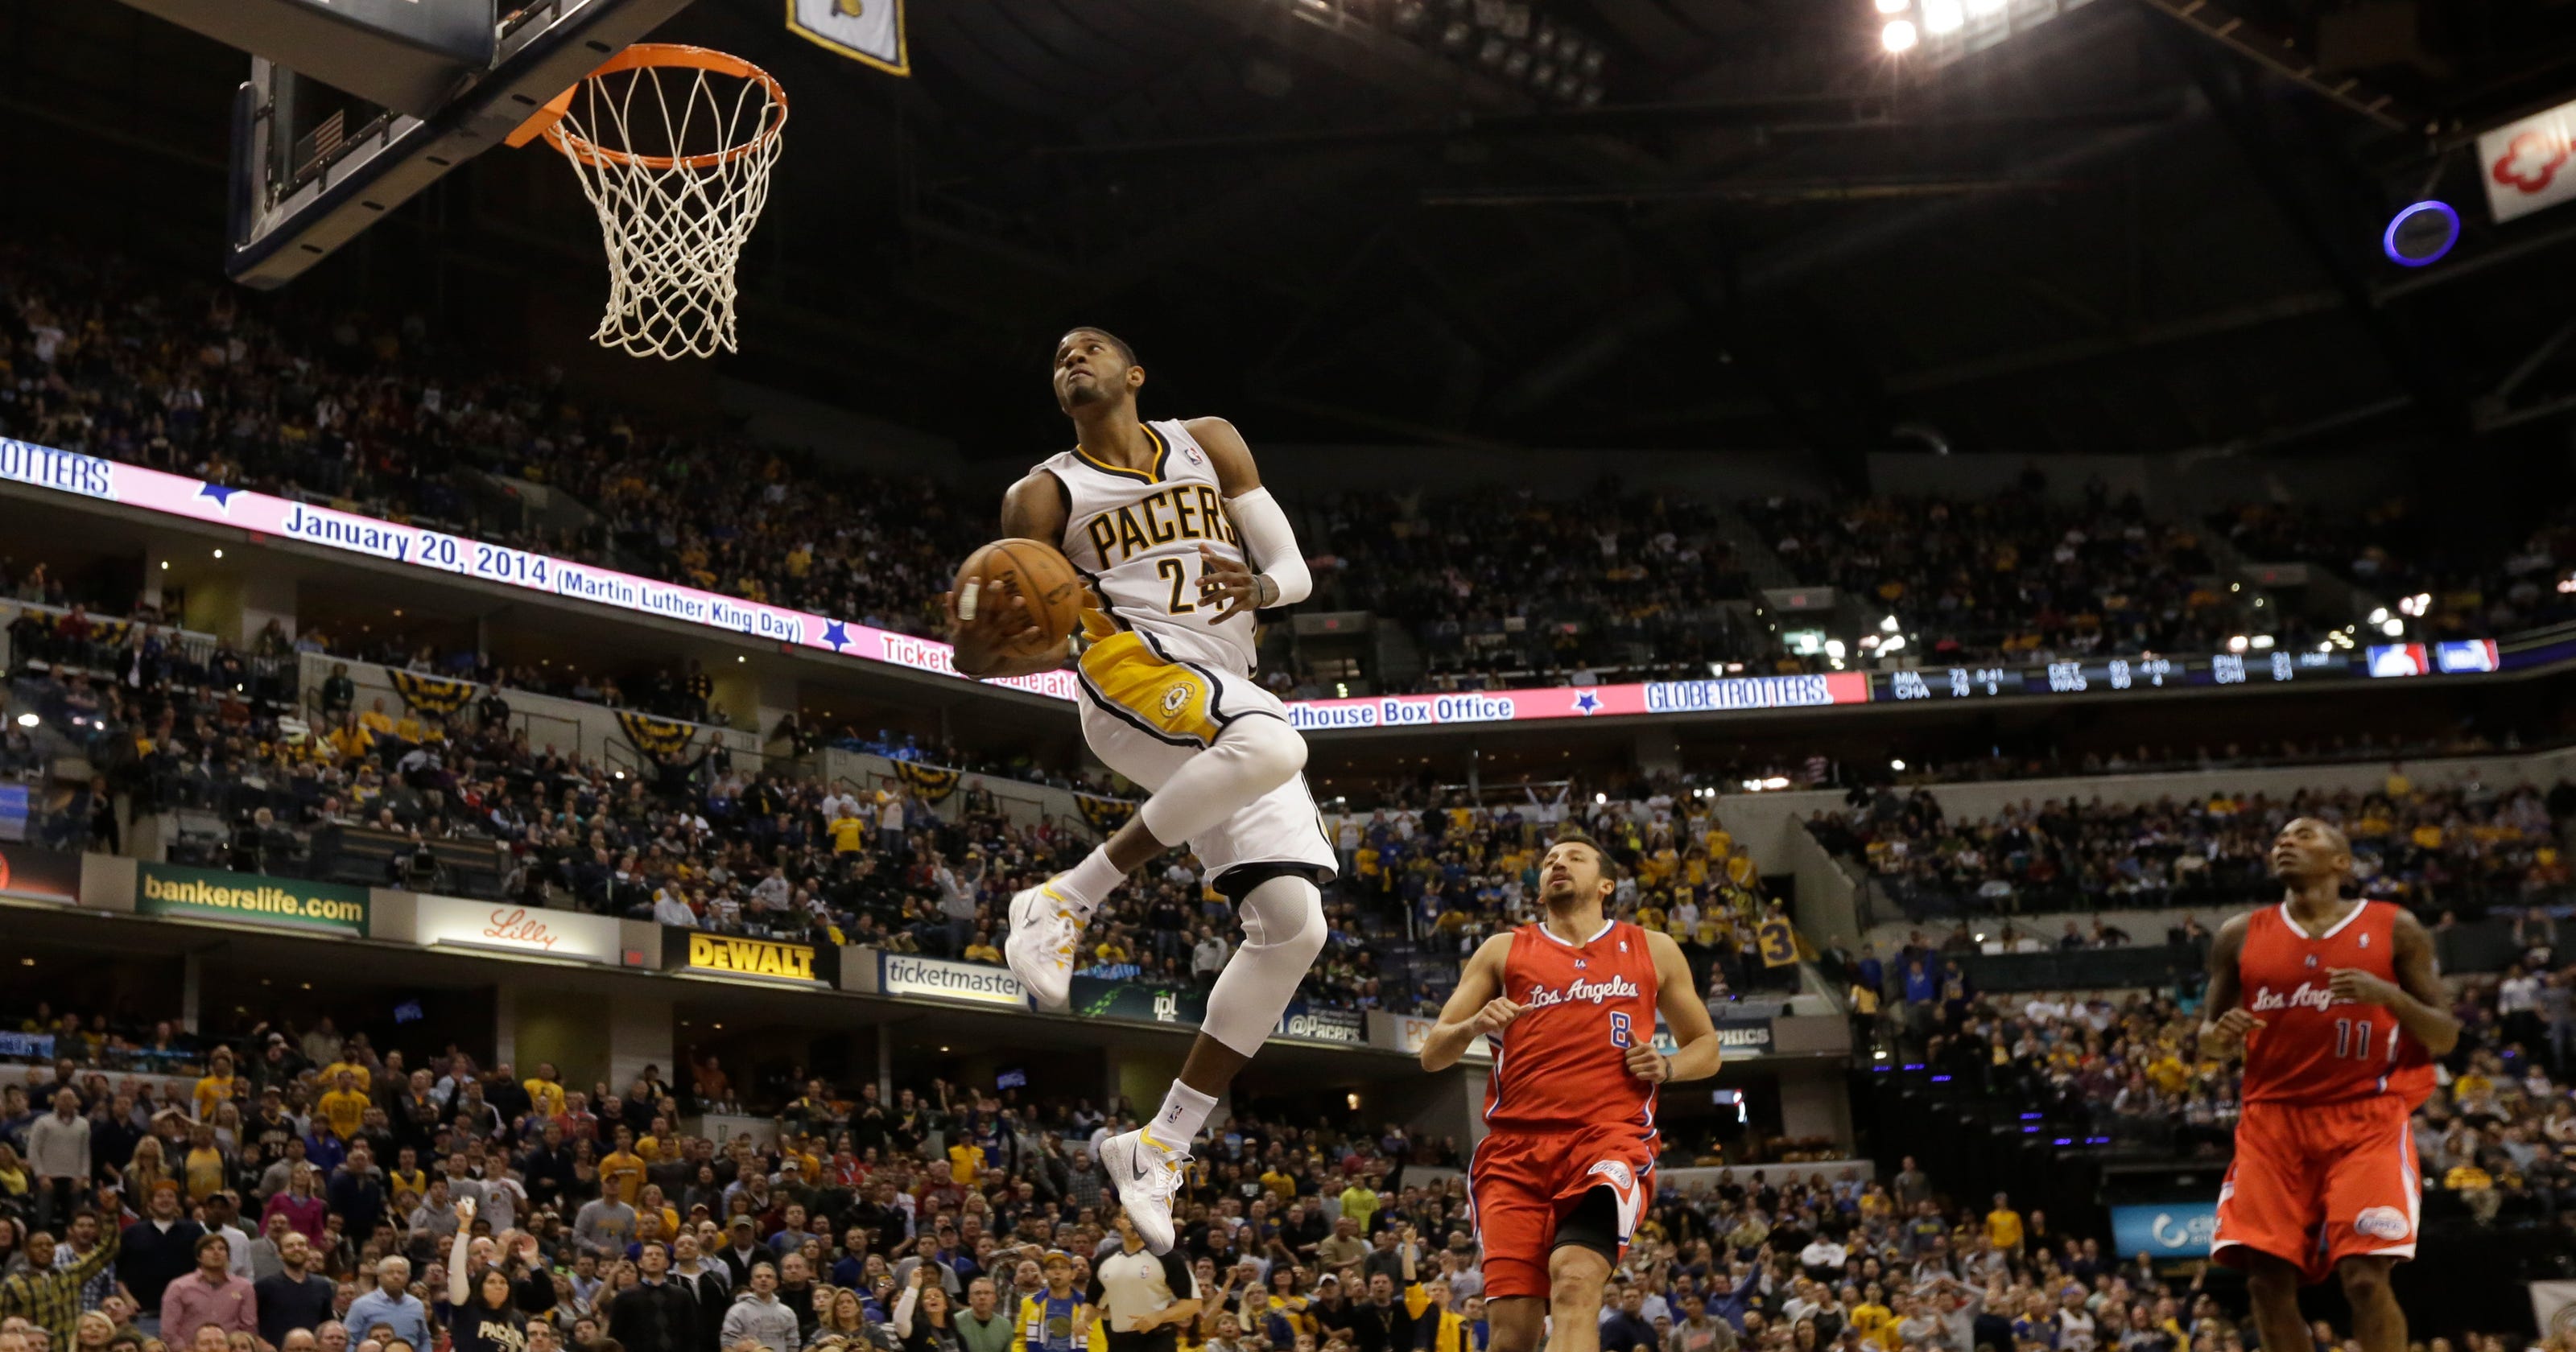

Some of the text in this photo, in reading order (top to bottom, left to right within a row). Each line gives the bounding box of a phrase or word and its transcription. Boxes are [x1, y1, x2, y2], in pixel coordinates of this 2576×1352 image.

[2, 443, 109, 493] OTTERS
[287, 508, 801, 644] January 20, 2014 (Martin Luther King Day)
[884, 637, 958, 672] Ticket
[1047, 675, 1066, 696] at
[1893, 671, 1922, 685] MIA
[1645, 674, 1827, 710] GLOBETROTTERS
[1289, 698, 1511, 726] dhouse Box Office
[144, 872, 362, 922] bankerslife.com
[483, 908, 558, 951] Lilly
[1761, 924, 1794, 961] 3
[889, 959, 1022, 995] ticketmaster
[1530, 975, 1639, 1008] Los Angeles
[2252, 986, 2285, 1012] Los
[1289, 1014, 1360, 1041] @Pacers
[1610, 1011, 1631, 1049] 8
[2335, 1017, 2372, 1061] 11
